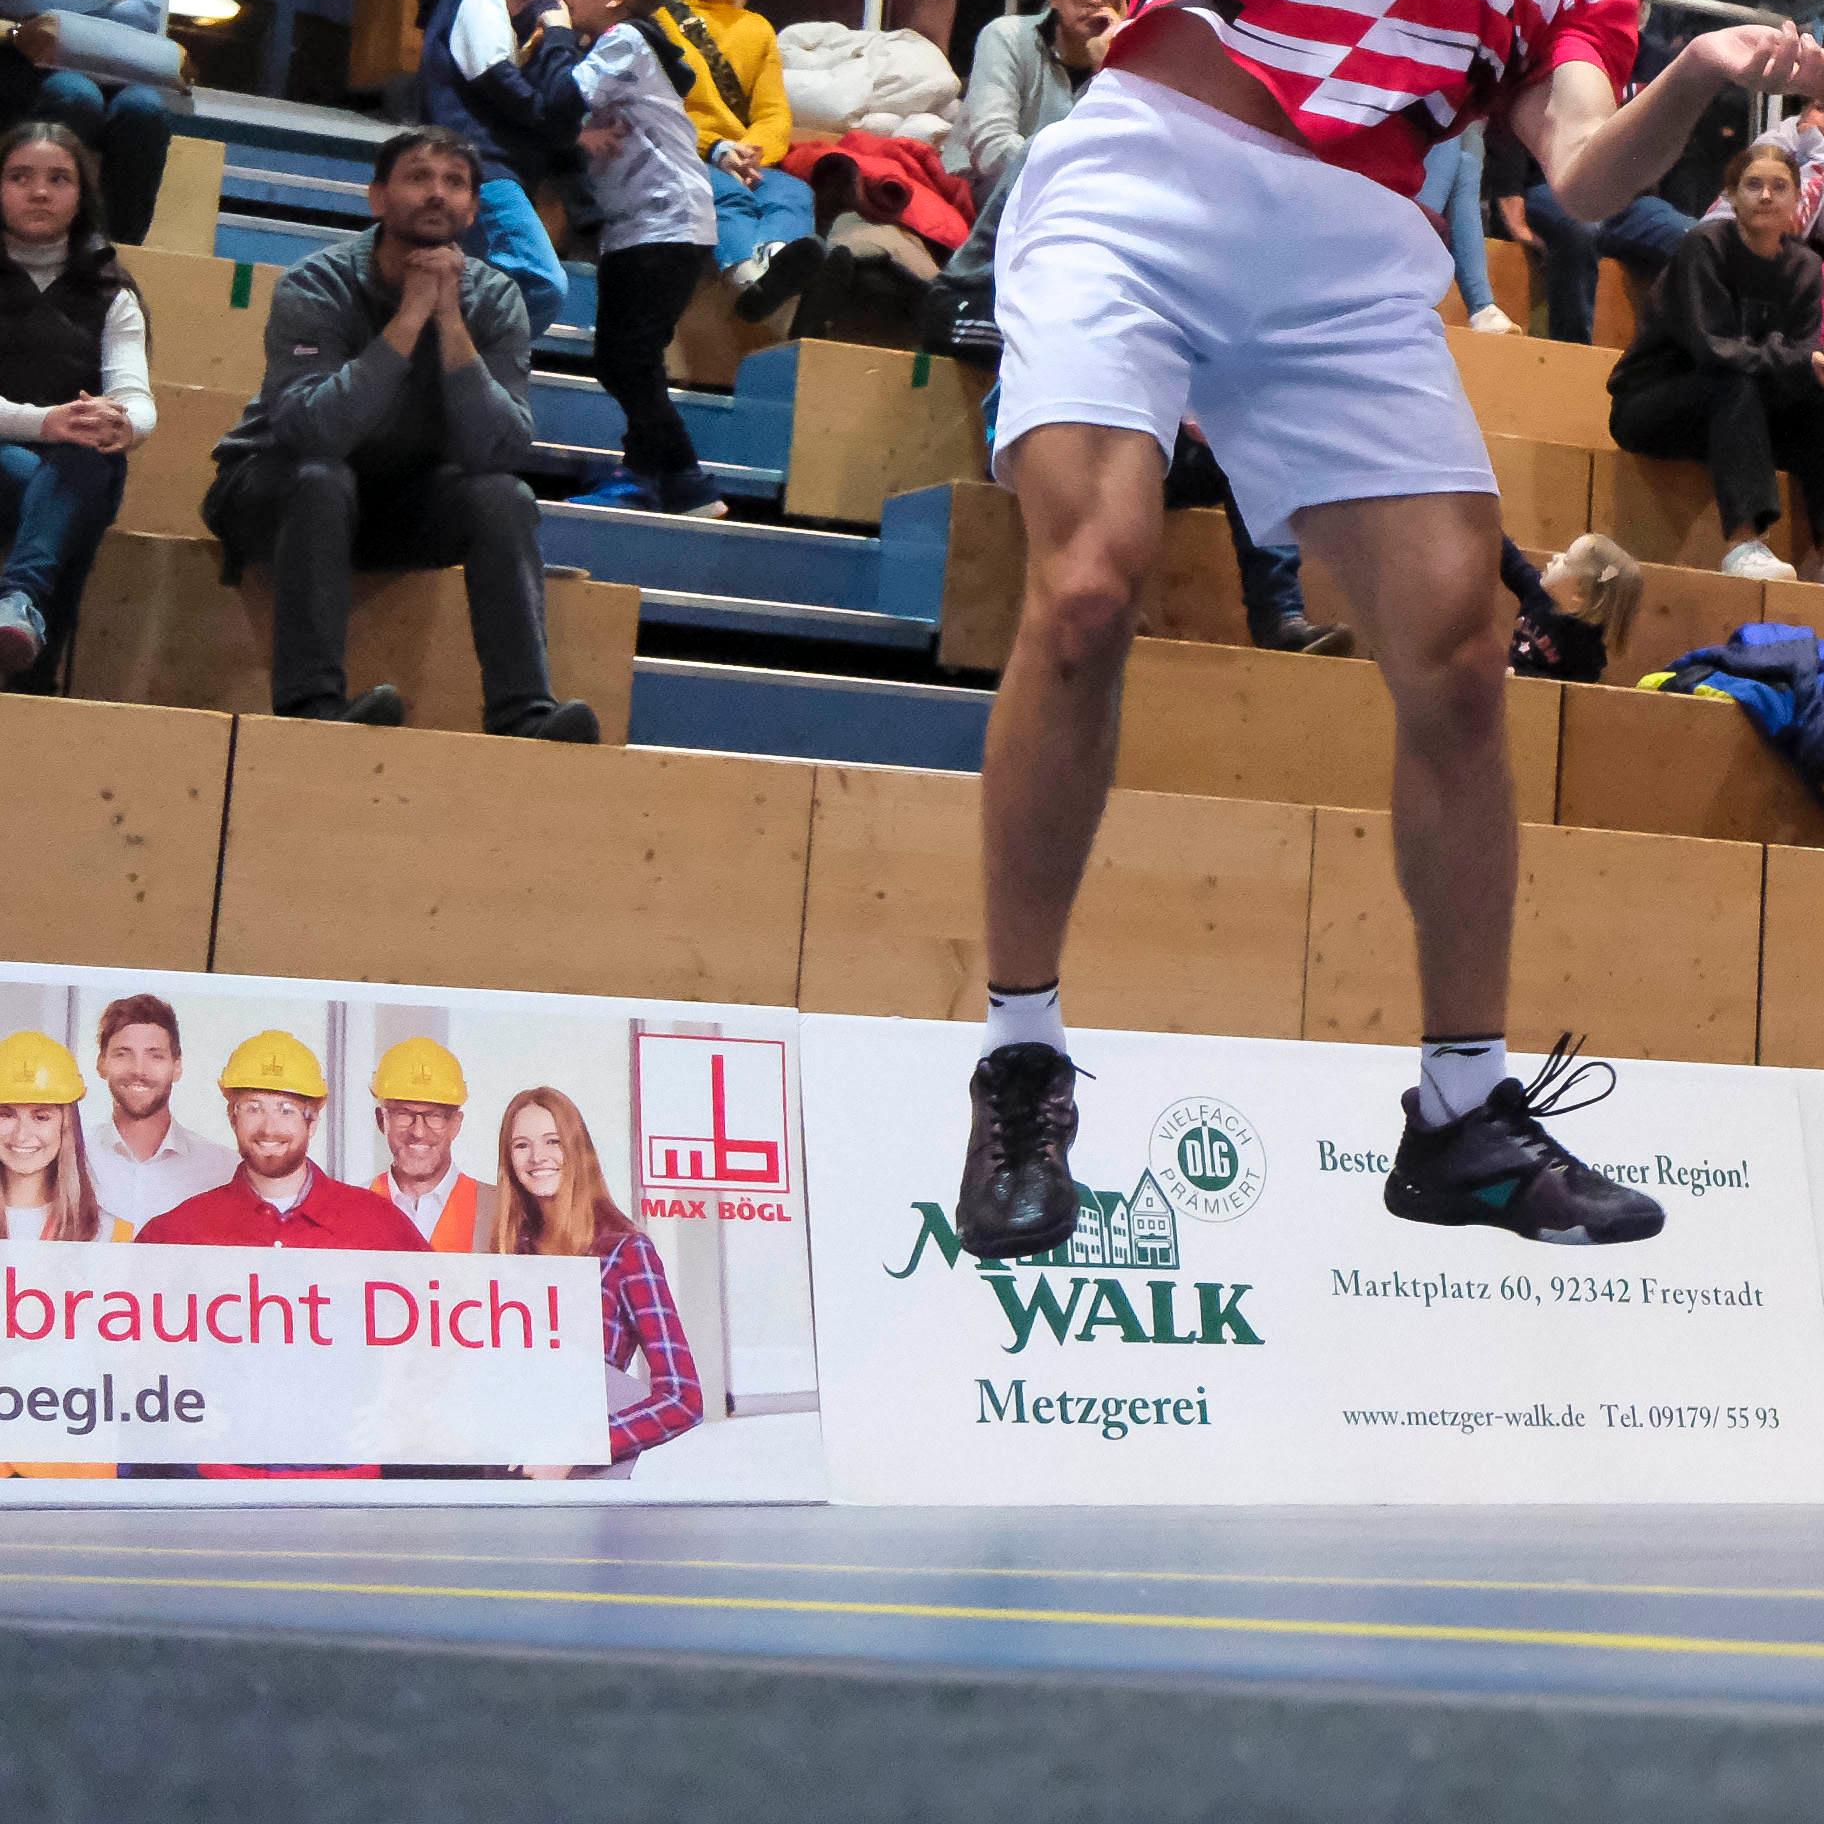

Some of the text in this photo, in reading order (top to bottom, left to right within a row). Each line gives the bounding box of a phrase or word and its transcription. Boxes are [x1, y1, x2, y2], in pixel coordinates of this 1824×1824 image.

[1158, 1104, 1253, 1146] VIELFACH
[1184, 1125, 1231, 1178] DLG
[1160, 1167, 1261, 1215] PRÄMIERT
[1316, 1139, 1751, 1197] Beste serer Region!
[640, 1196, 792, 1222] MAX BÖGL
[6, 1266, 561, 1349] braucht Dich!
[980, 1271, 1266, 1354] WALK
[1331, 1268, 1765, 1313] Marktplatz 60, 92342 Freystadt
[0, 1373, 206, 1436] oegl.de
[974, 1377, 1212, 1441] Metzgerei
[1342, 1404, 1586, 1434] www.metzger-walk.de
[1600, 1403, 1645, 1429] Tel.
[1648, 1404, 1720, 1430] 09179/
